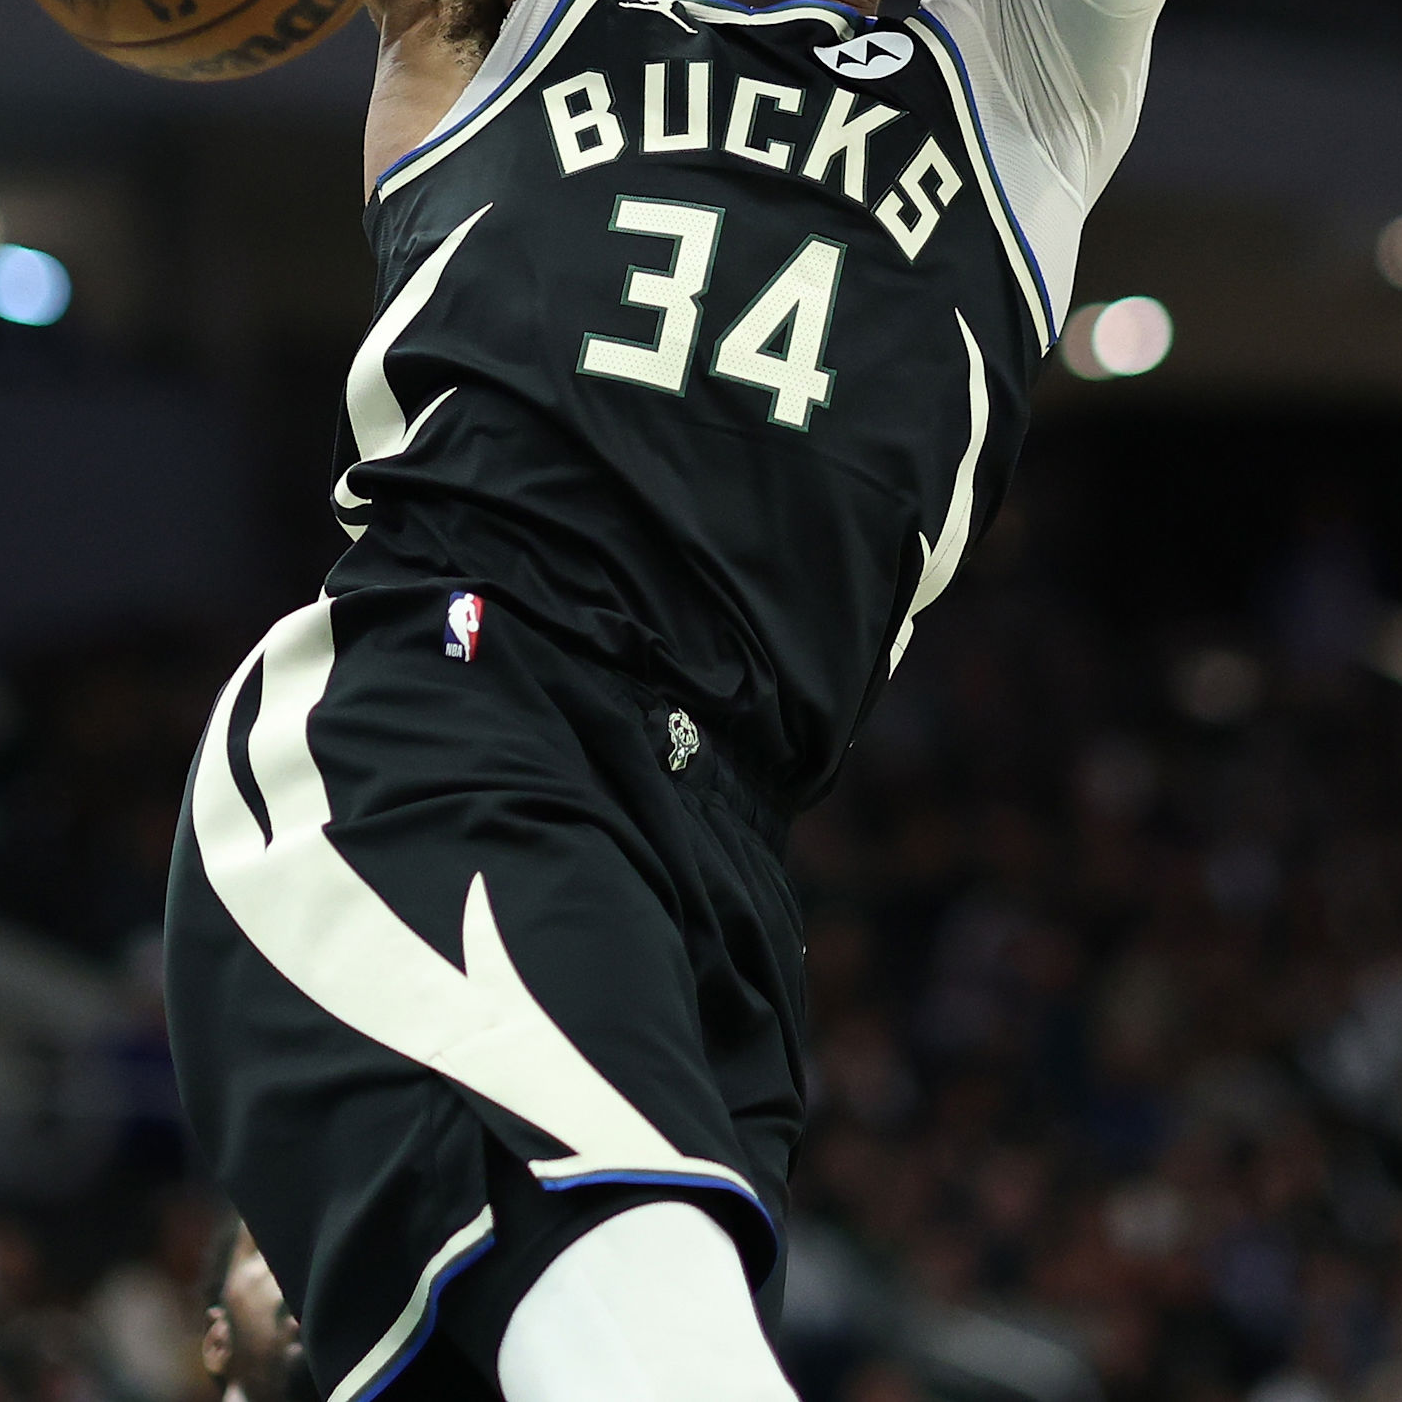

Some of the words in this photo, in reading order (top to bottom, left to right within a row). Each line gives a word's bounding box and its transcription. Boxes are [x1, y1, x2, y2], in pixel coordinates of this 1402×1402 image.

[541, 59, 964, 265] BUCKS
[575, 194, 848, 432] 34
[445, 642, 463, 658] NBA
